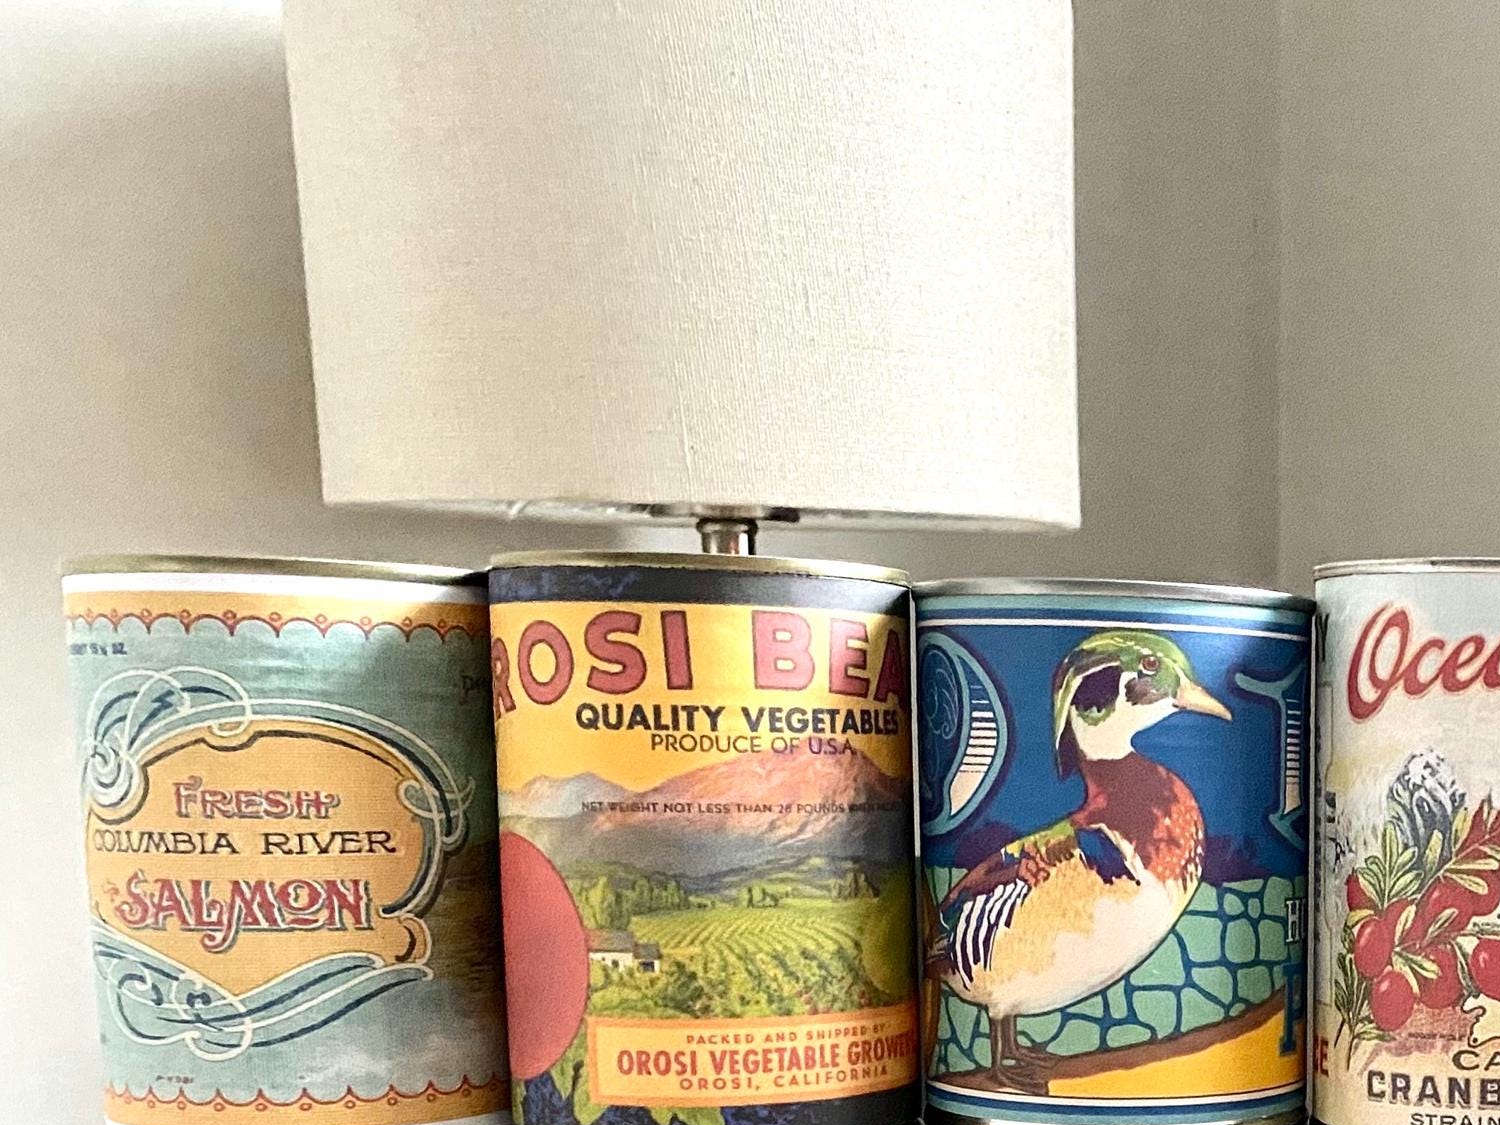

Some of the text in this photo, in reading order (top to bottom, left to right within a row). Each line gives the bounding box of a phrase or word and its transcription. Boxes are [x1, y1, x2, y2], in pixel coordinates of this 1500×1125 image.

[575, 703, 899, 735] QUALITY VEGETABLES
[651, 734, 858, 756] PRODUCE OF U.S.A.
[174, 776, 340, 819] FRESH
[582, 802, 603, 812] NET
[608, 802, 658, 813] WEIGHT
[663, 802, 692, 814] NOT
[698, 803, 730, 814] LESS
[736, 803, 772, 814] THAN
[797, 803, 844, 814] POUNDS
[92, 831, 396, 856] COLUMBIA RIVER
[112, 869, 374, 953] SALMON
[686, 1023, 885, 1045] PACKED AND SHIPPED BY
[617, 1050, 697, 1076] OROSI
[710, 1043, 840, 1075] VEGETABLE
[680, 1066, 888, 1091] OROSI, CALIFORNIA
